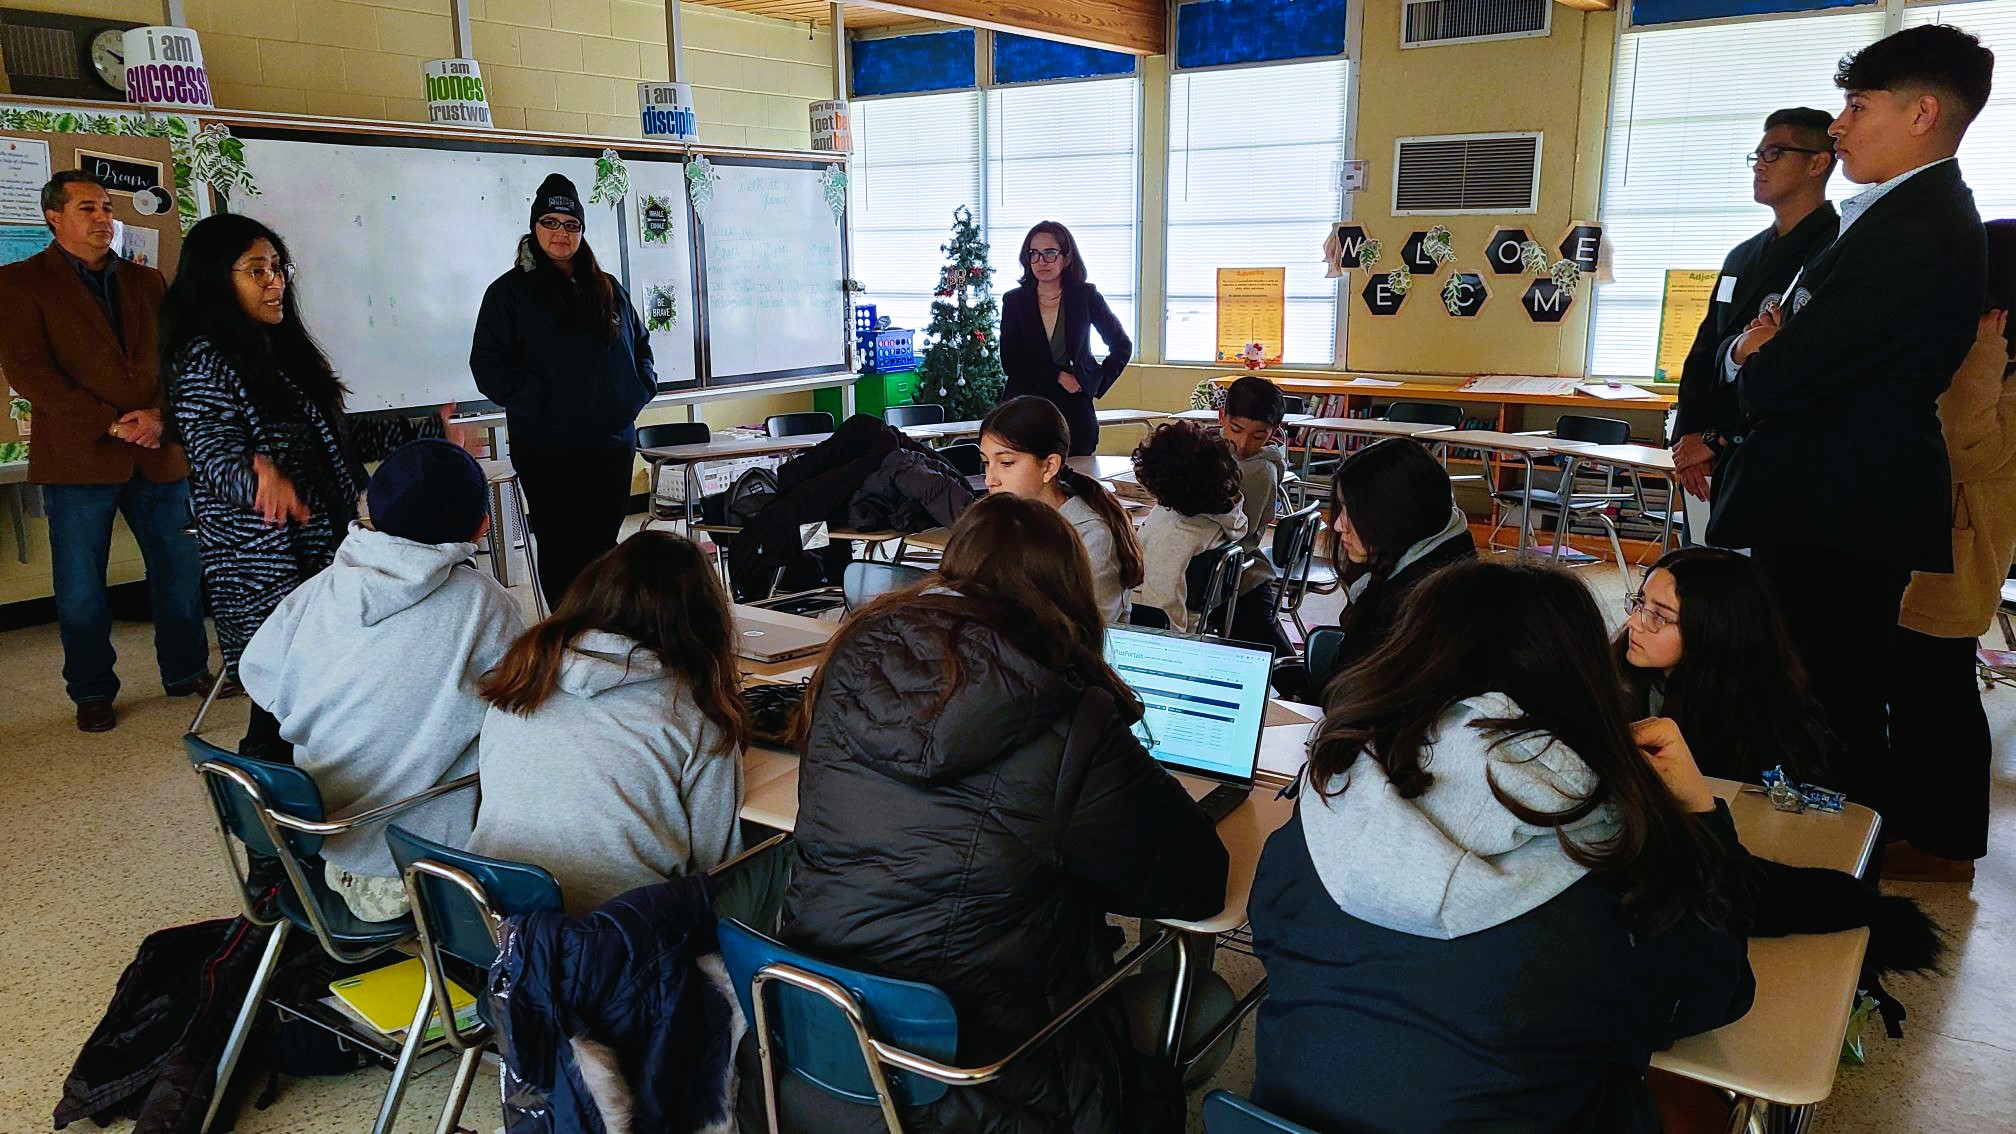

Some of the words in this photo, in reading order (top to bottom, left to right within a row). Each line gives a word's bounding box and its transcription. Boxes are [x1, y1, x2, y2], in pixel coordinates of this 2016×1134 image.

[146, 30, 156, 61] i
[161, 35, 194, 63] am
[442, 61, 447, 74] i
[450, 63, 470, 75] am
[126, 64, 212, 106] success
[645, 85, 650, 104] i
[654, 88, 677, 104] am
[815, 115, 834, 133] get
[813, 134, 833, 150] and
[95, 160, 150, 186] Dream
[657, 298, 666, 306] BE
[652, 308, 670, 317] BRAVE
